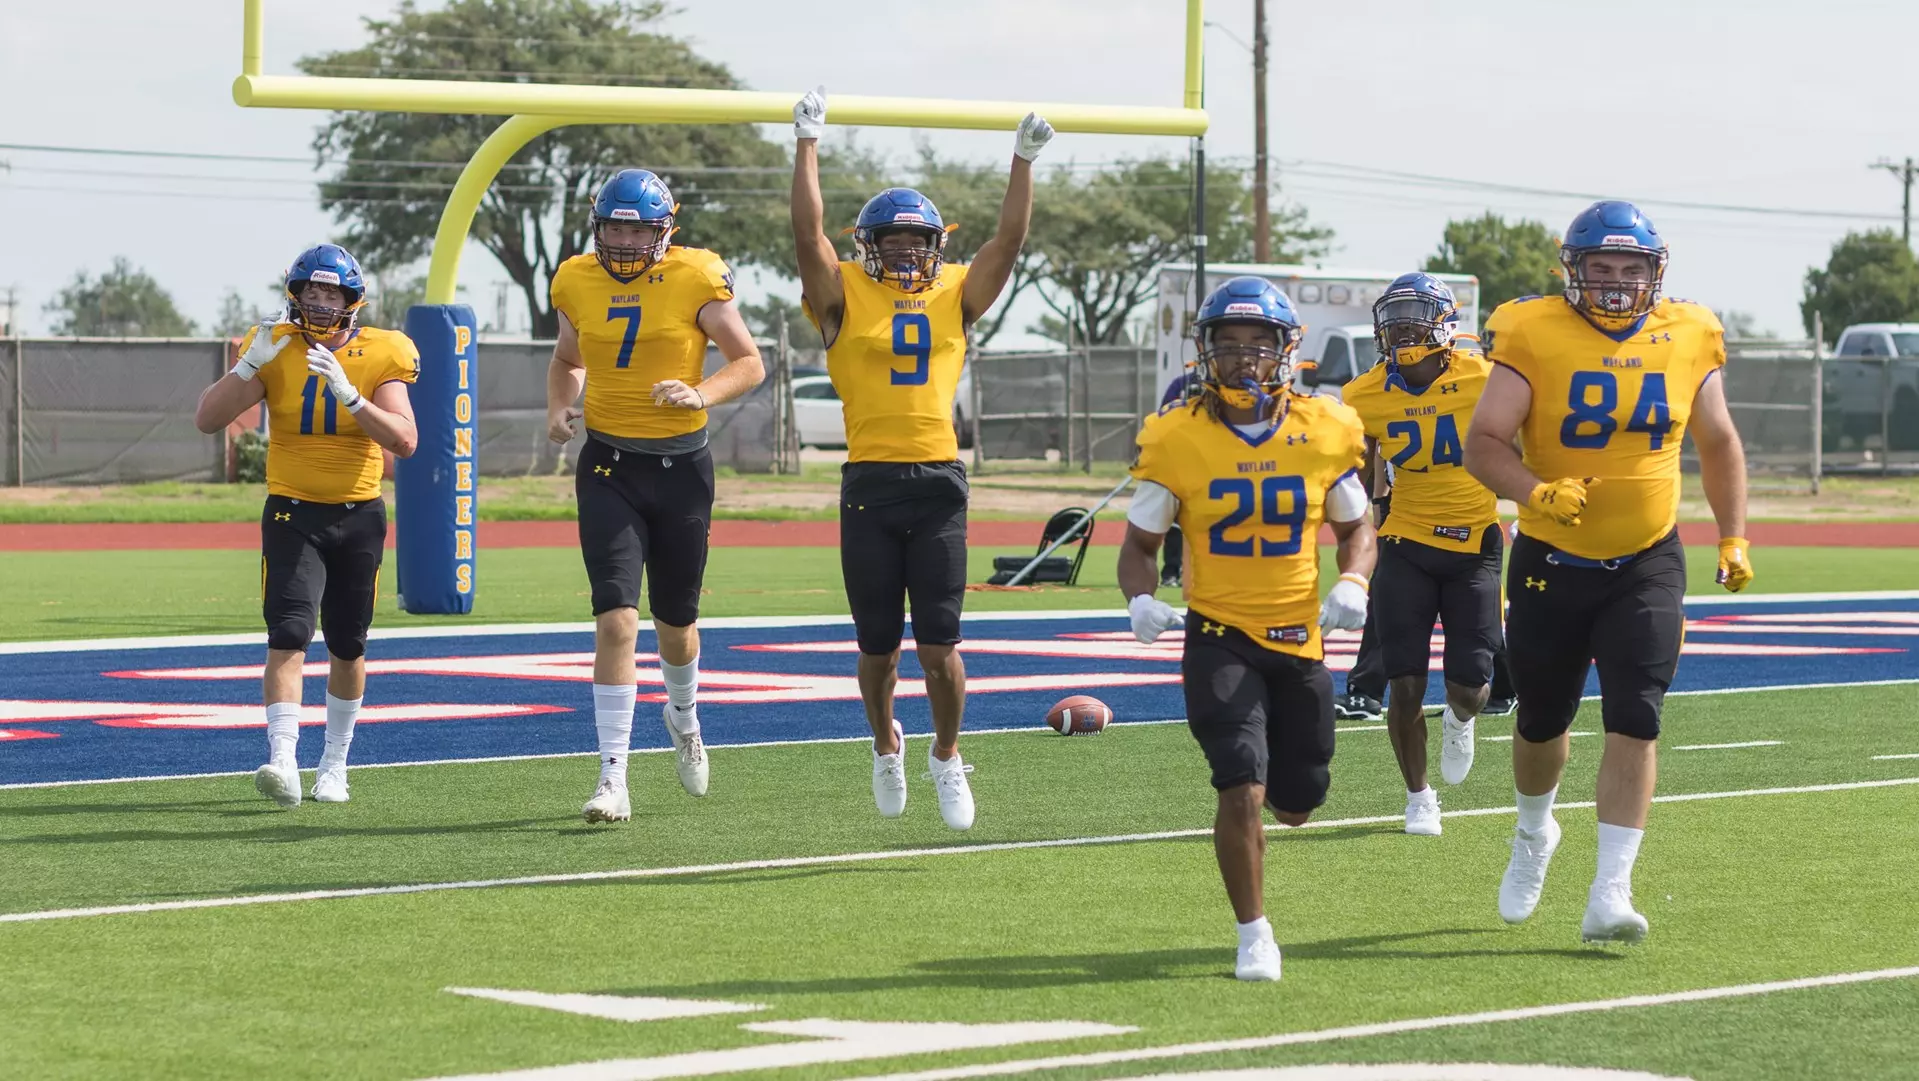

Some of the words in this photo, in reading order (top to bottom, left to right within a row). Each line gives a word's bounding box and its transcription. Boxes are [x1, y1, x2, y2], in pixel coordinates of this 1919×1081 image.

[313, 272, 338, 281] Riddell
[610, 294, 640, 304] WAYLAND
[894, 300, 926, 310] WAYLAND
[607, 306, 642, 369] 7
[890, 313, 932, 386] 9
[1602, 356, 1642, 368] WAYLAND
[300, 375, 338, 435] 11
[1404, 405, 1437, 417] WAYLAND
[1560, 371, 1675, 450] 84
[454, 326, 472, 594] PIONEERS
[1236, 460, 1277, 473] WAYLAND
[1386, 413, 1463, 473] 24
[1209, 475, 1307, 557] 29
